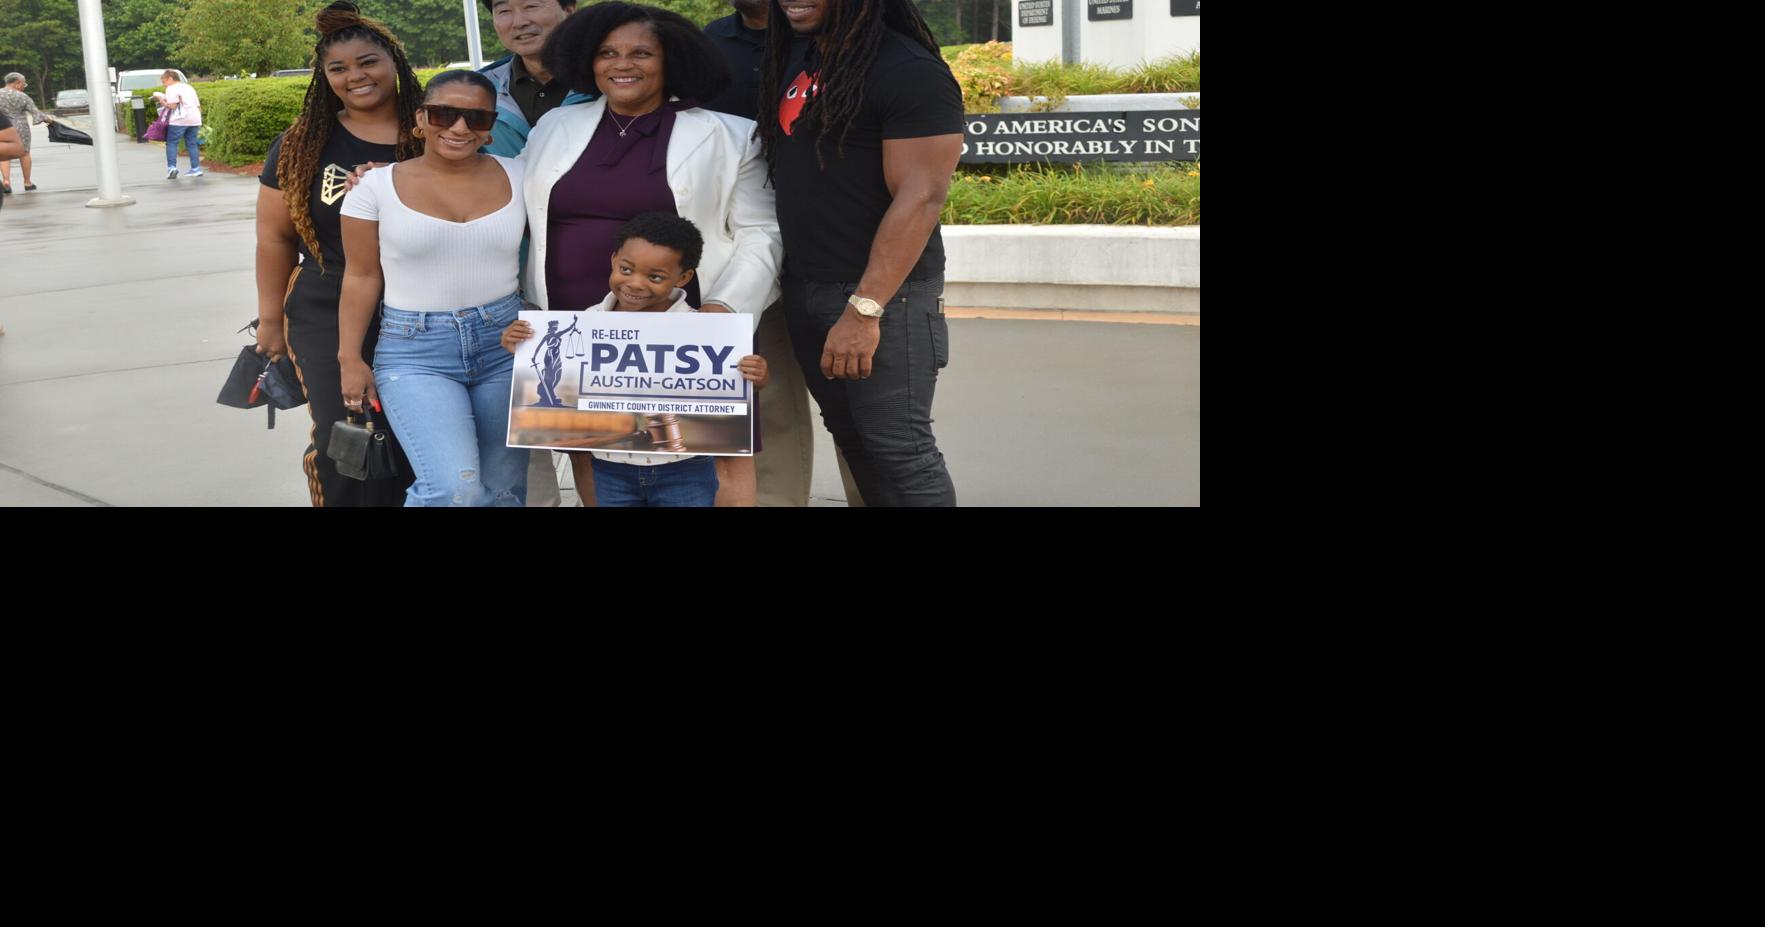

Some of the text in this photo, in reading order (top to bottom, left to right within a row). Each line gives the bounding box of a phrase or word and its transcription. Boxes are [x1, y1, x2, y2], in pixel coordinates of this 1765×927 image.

[966, 118, 1200, 135] O AMERICA'S SON
[976, 140, 1138, 155] HONORABLY
[1144, 139, 1175, 154] IN
[591, 329, 640, 340] RE-ELECT
[591, 343, 735, 375] PATSY
[590, 375, 736, 391] AUSTIN-GATSON
[588, 401, 735, 414] GWINNETT COUNTY DISTRICT ATTORNEY
